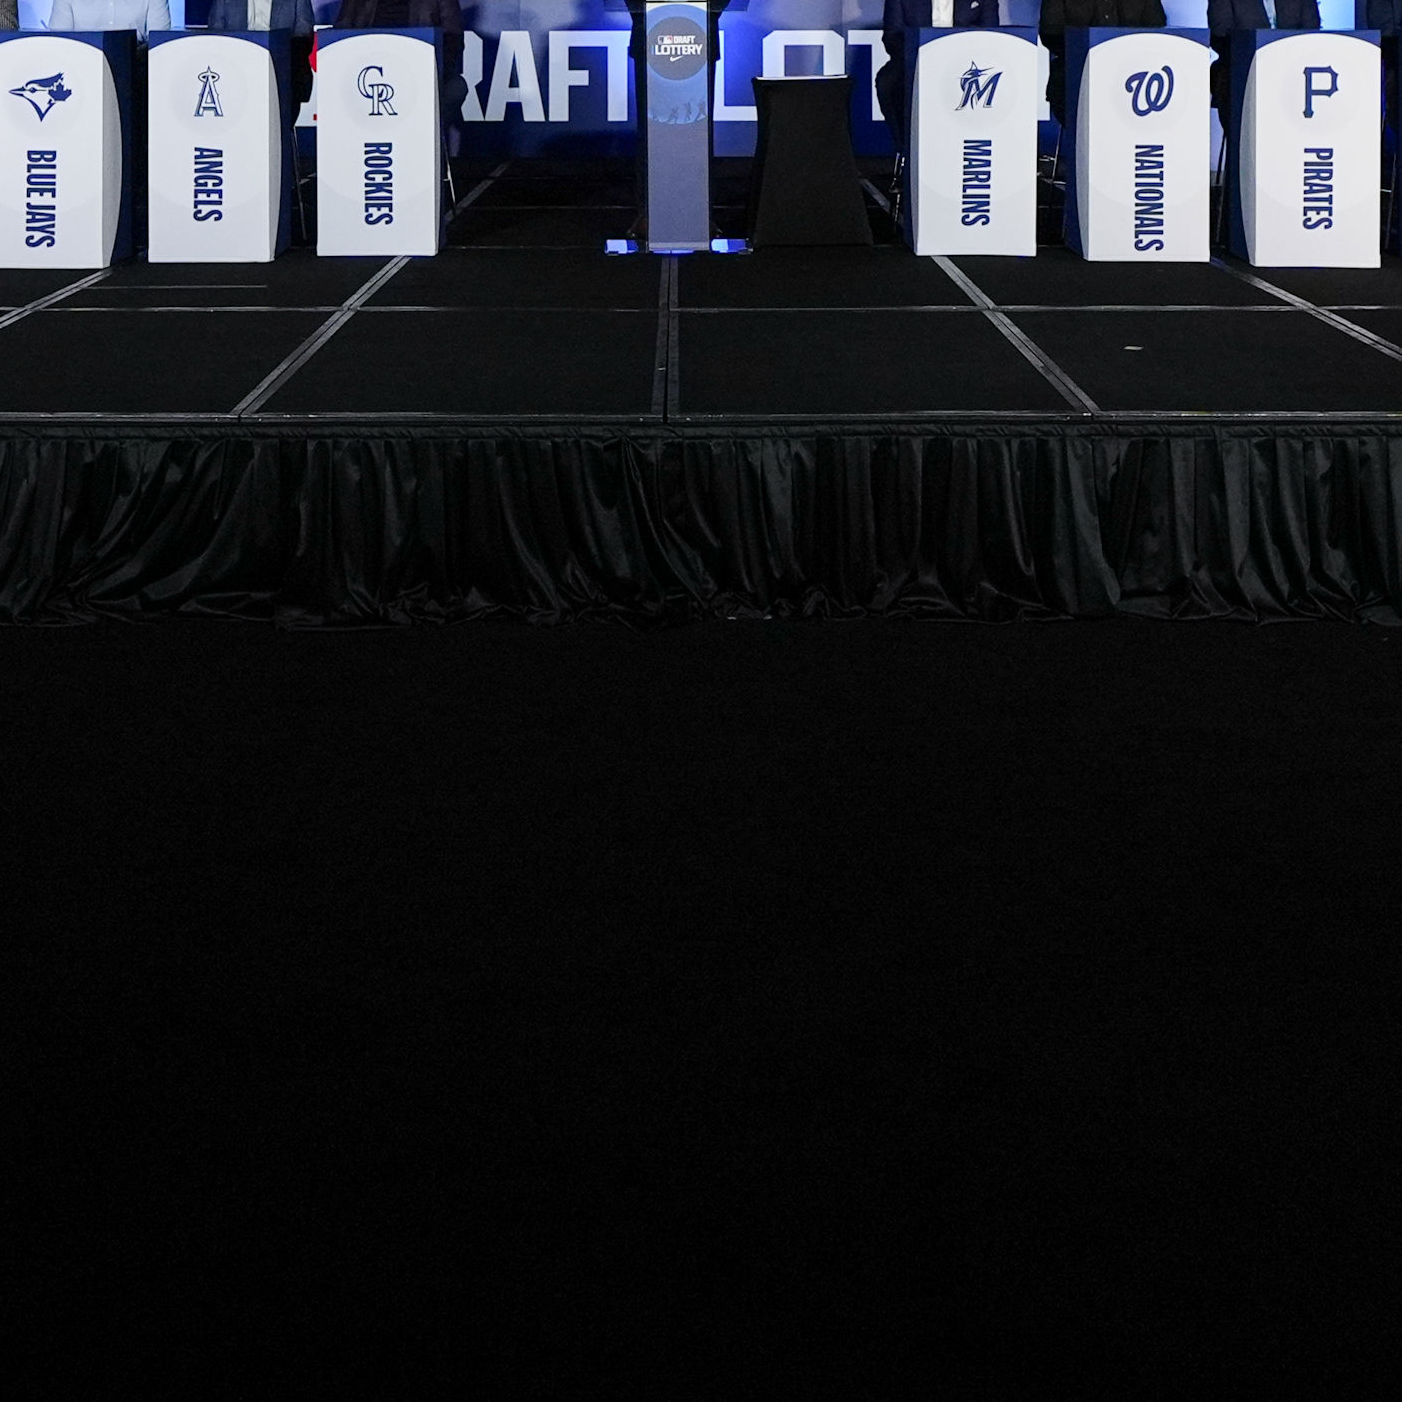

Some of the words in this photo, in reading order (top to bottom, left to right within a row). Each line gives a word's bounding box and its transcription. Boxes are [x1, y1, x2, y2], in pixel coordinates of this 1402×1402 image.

[655, 44, 703, 55] LOTTERY
[673, 35, 696, 44] DRAFT
[1124, 65, 1175, 117] W
[1302, 65, 1339, 119] P
[26, 149, 57, 198] BLUE
[193, 146, 224, 222] ANGELS
[363, 142, 394, 226] ROCKIES
[961, 139, 992, 227] MARLINS
[1133, 144, 1165, 252] NATIONALS
[1302, 147, 1334, 230] PIRATES
[25, 201, 56, 248] JAYS
